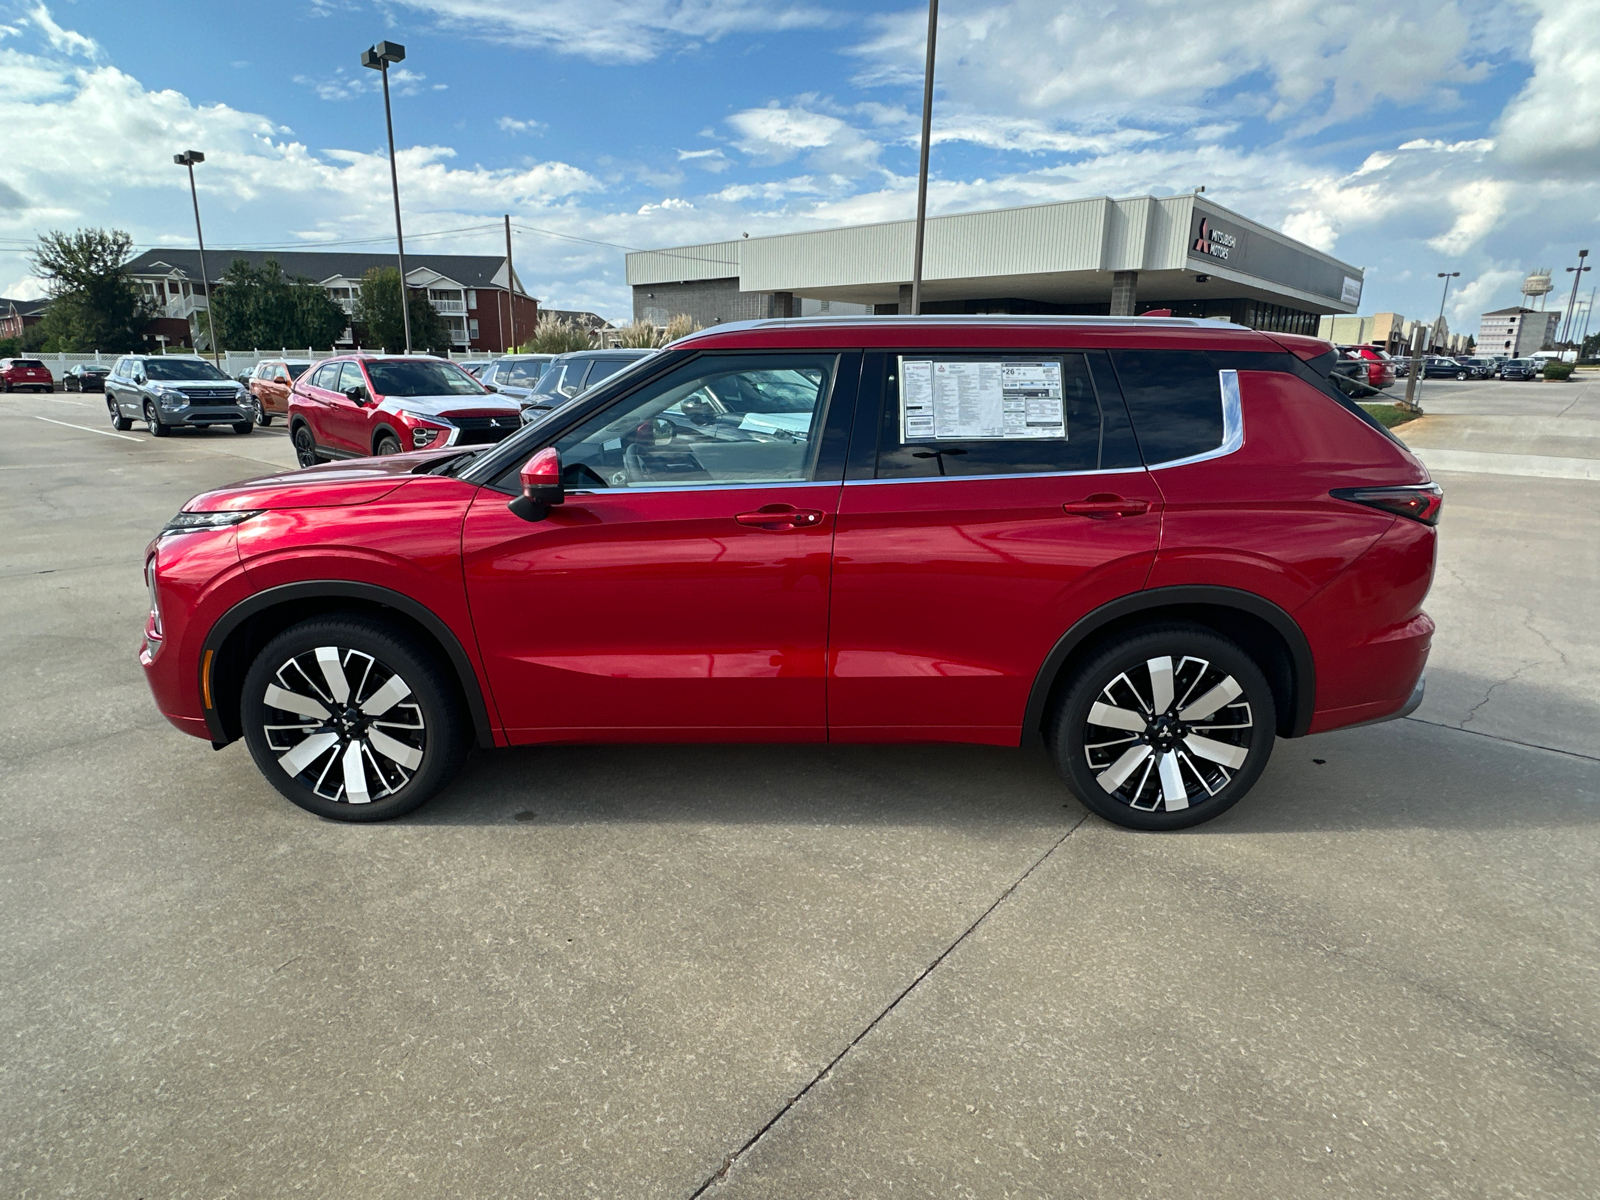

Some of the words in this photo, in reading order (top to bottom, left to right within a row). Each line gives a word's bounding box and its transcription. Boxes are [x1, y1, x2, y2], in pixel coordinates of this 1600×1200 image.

[1211, 229, 1236, 248] MITSUBISHI
[1209, 243, 1229, 259] MOTORS
[1006, 368, 1015, 376] 26
